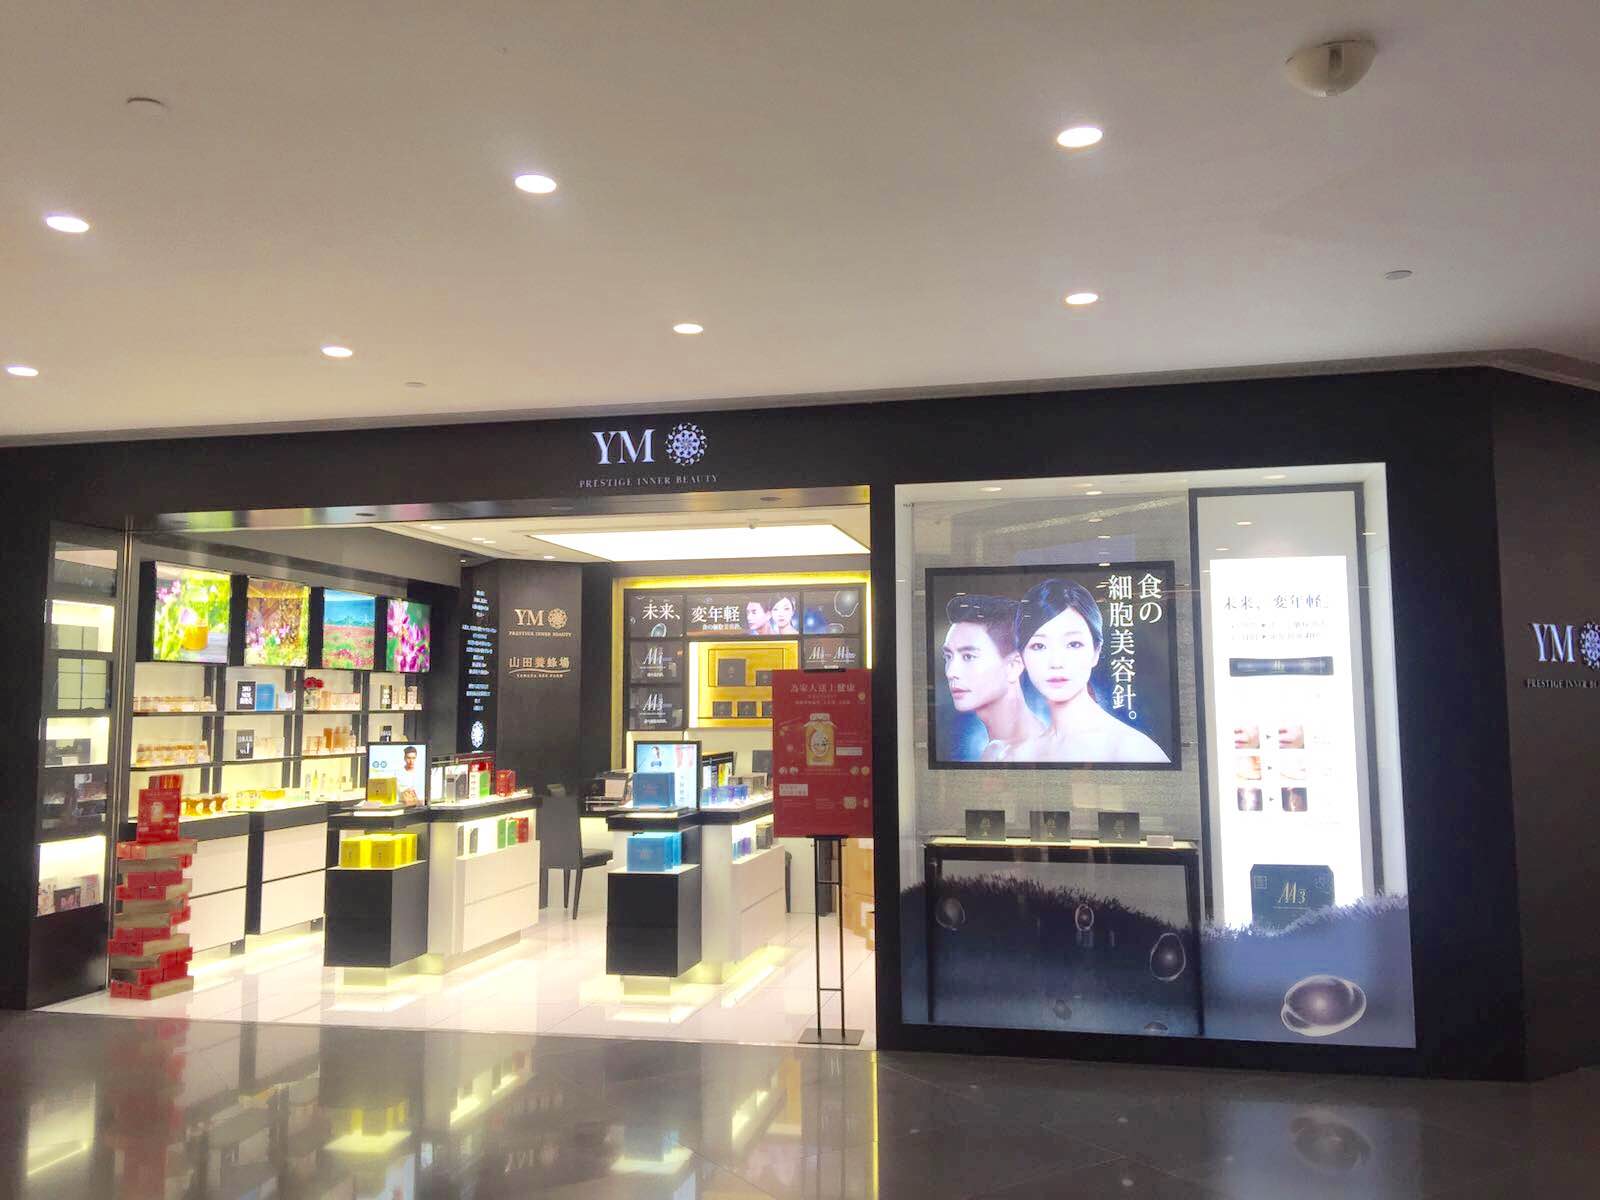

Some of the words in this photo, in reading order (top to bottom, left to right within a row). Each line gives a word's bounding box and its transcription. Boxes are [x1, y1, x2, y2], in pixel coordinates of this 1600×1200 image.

[592, 429, 656, 465] YM
[579, 478, 633, 489] PRESTIGE
[637, 476, 671, 486] INNER
[676, 474, 718, 484] BEAUTY
[1138, 573, 1163, 624] 食の
[514, 608, 544, 627] YM
[1108, 574, 1137, 720] 細胞美容針。
[1531, 623, 1576, 664] YM
[1527, 679, 1564, 689] PRESTIGE
